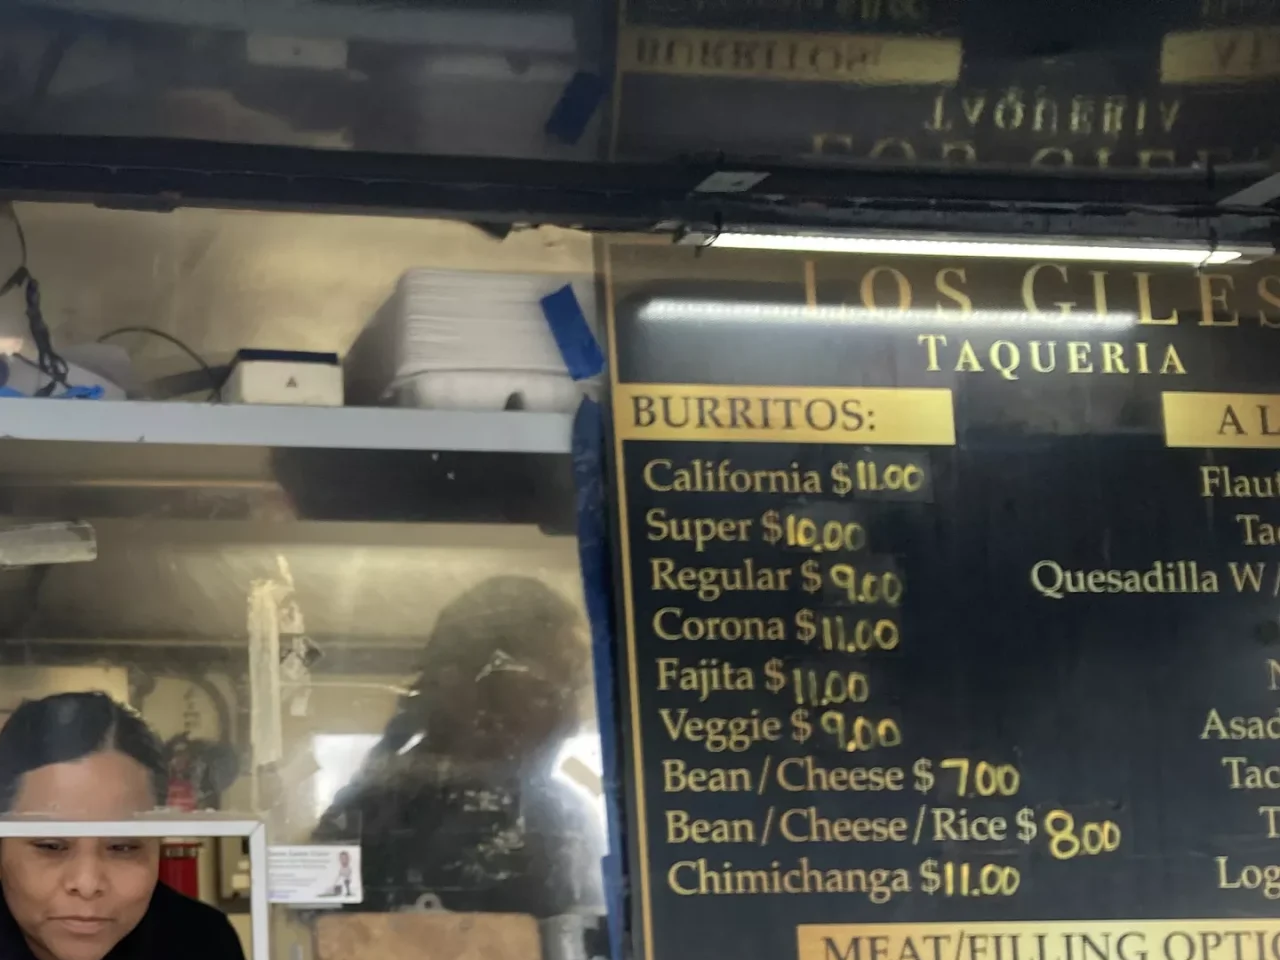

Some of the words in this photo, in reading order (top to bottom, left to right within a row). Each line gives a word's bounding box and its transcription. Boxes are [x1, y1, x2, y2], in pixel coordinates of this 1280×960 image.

[918, 333, 1188, 380] TAQUERIA
[631, 395, 876, 433] BURRITOS:
[643, 458, 822, 494] California
[647, 509, 753, 552] Super
[651, 558, 791, 600] Regular
[1031, 559, 1220, 598] Quesadilla
[652, 606, 786, 643] Corona
[656, 657, 755, 699] Fajita
[659, 707, 783, 752] Veggie
[668, 860, 912, 905] Chimichanga
